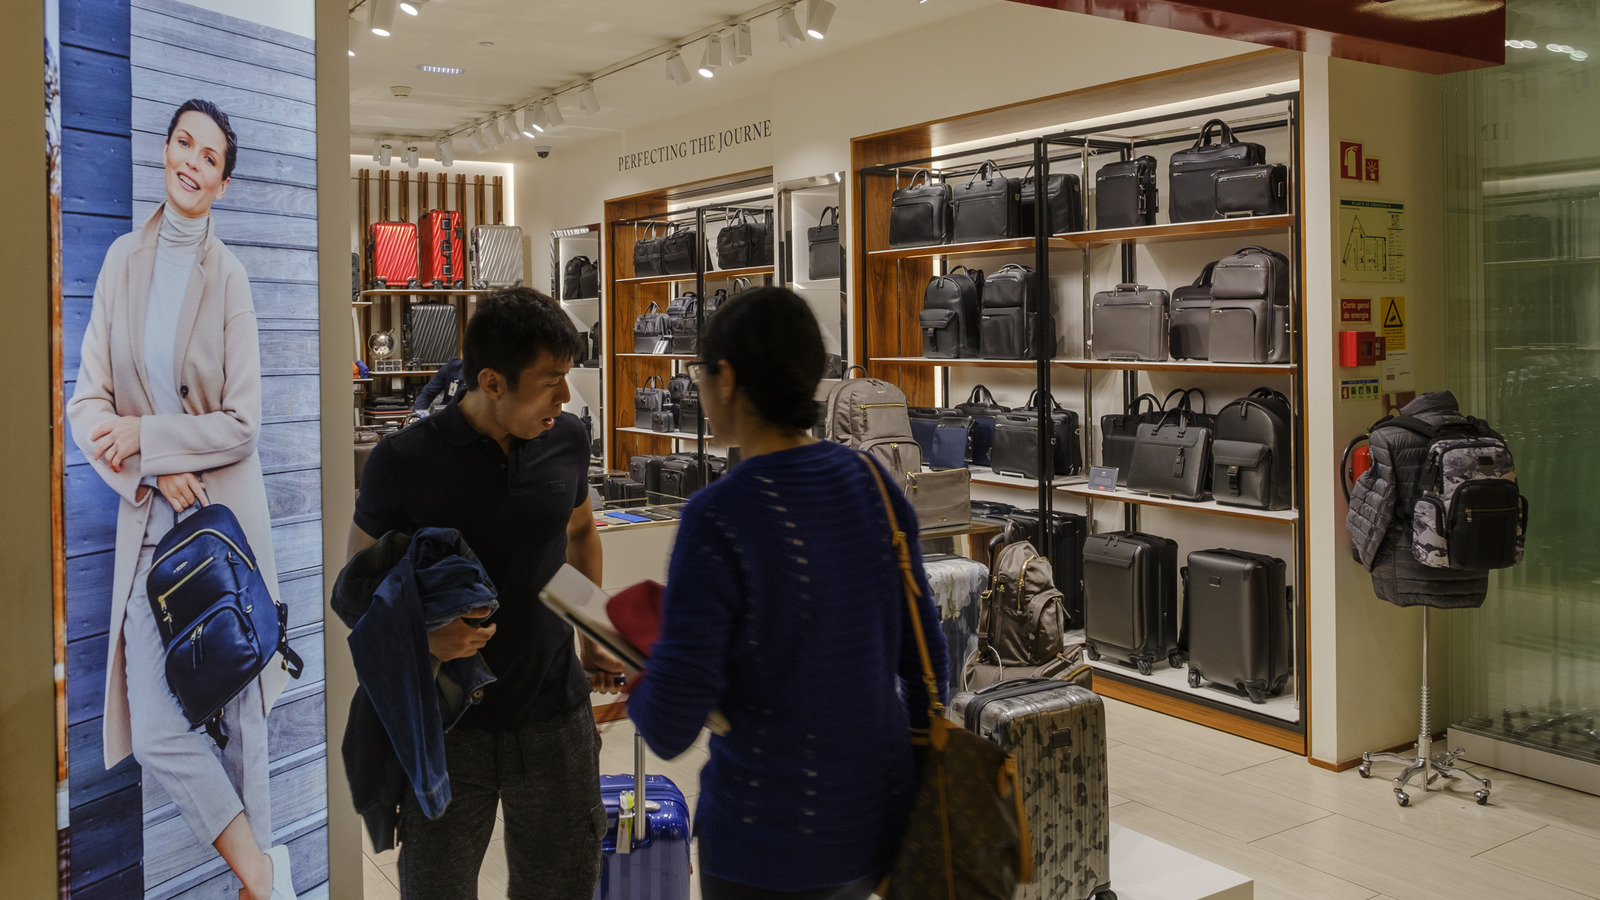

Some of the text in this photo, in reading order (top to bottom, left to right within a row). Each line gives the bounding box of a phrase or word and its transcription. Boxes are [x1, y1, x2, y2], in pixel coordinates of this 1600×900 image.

[618, 119, 772, 171] PERFECTING THE JOURNE
[1342, 301, 1370, 310] Corte geral
[1350, 312, 1369, 320] energia
